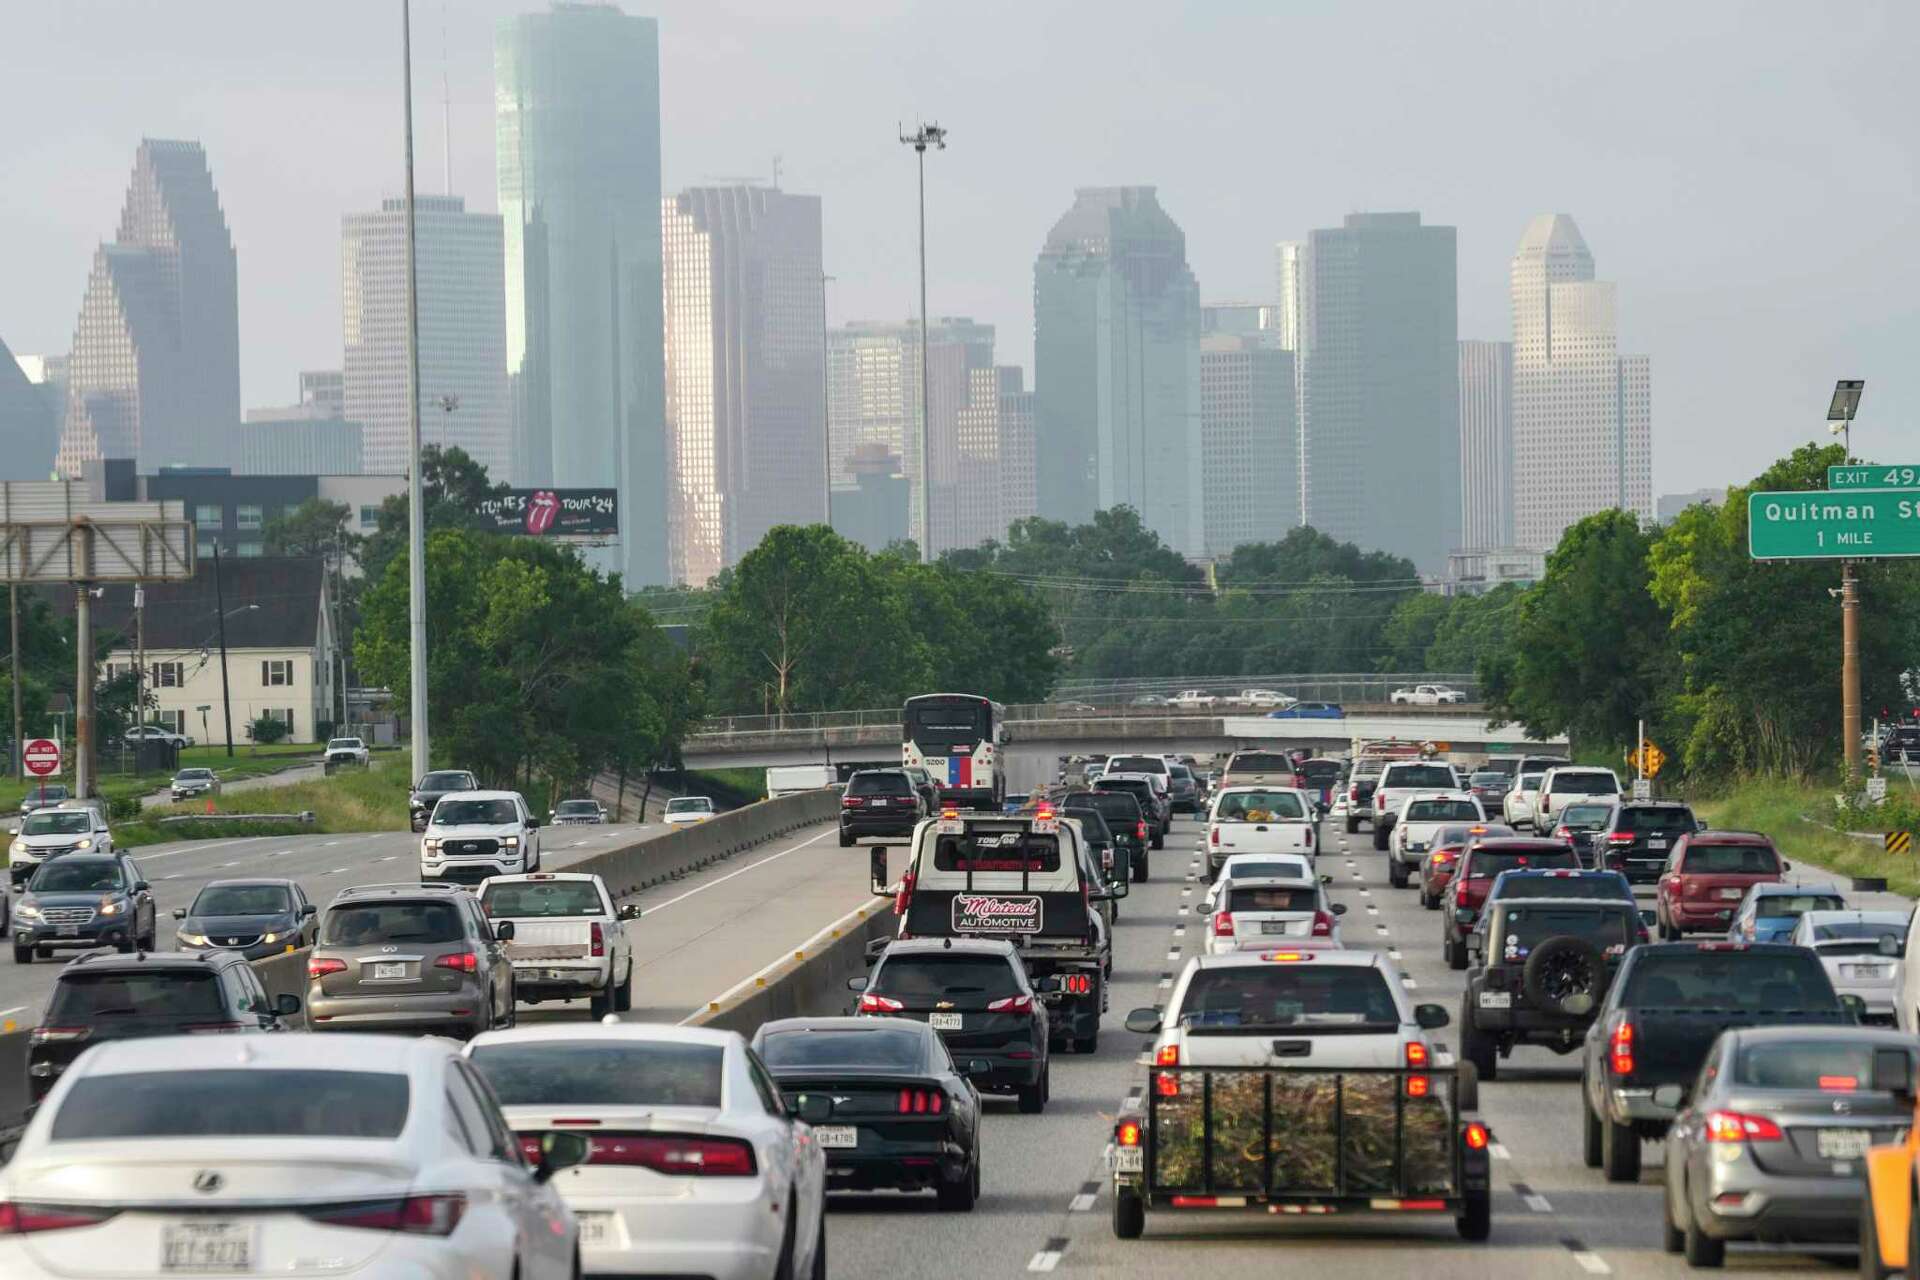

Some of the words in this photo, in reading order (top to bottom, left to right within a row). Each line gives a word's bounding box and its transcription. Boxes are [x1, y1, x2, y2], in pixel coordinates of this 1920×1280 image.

[1835, 472, 1869, 484] EXIT
[561, 498, 591, 510] TOUR
[1765, 503, 1875, 521] Quitman
[1817, 531, 1824, 547] 1
[1837, 532, 1873, 544] MILE
[958, 892, 1037, 919] Milstead
[960, 919, 1036, 927] AUTOMOTIVE
